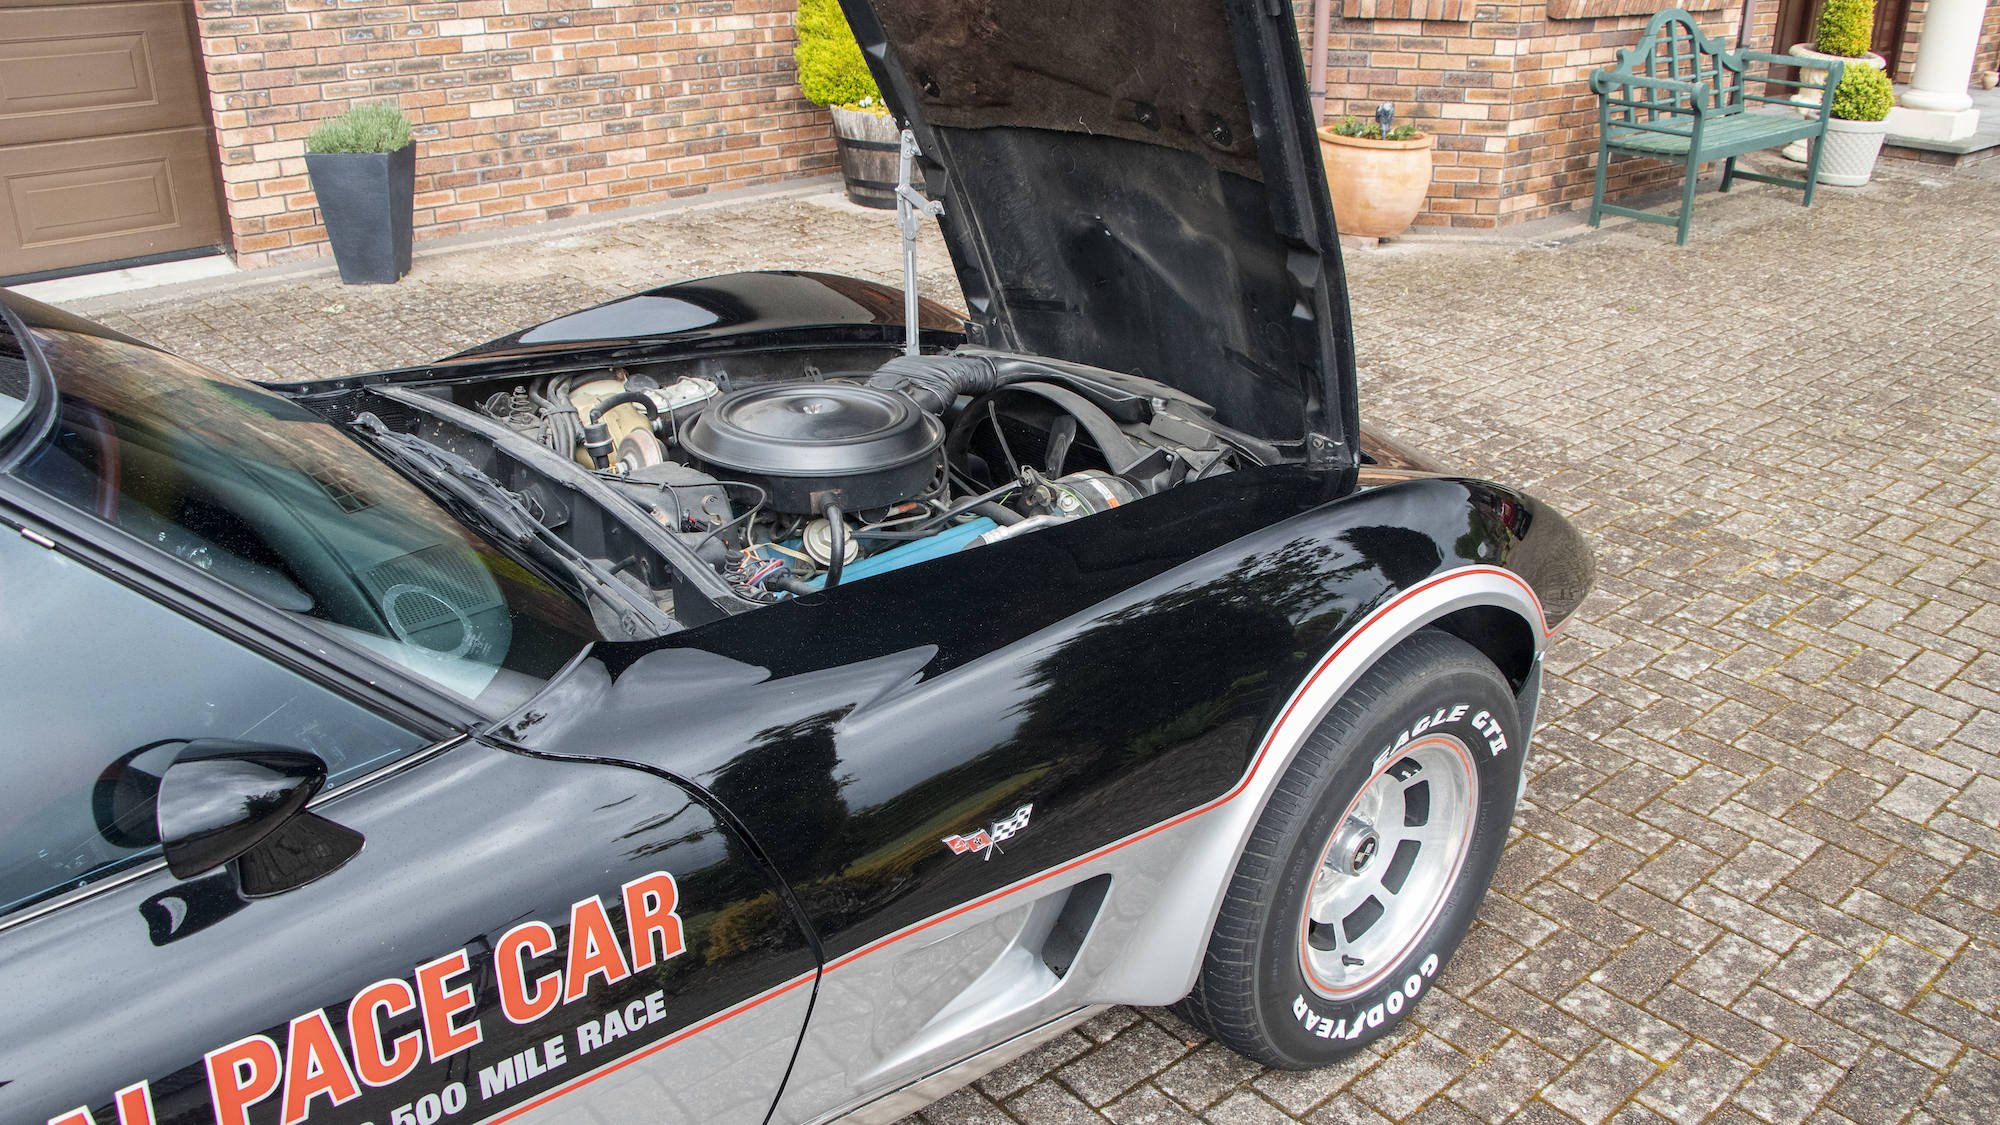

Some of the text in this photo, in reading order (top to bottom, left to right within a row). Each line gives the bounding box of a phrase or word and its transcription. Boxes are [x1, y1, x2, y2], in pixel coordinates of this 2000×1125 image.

[1371, 704, 1470, 776] EAGLE
[203, 870, 687, 1125] PACE CAR
[1292, 953, 1439, 1040] GOODYEAR
[391, 989, 667, 1125] 500 MILE RACE
